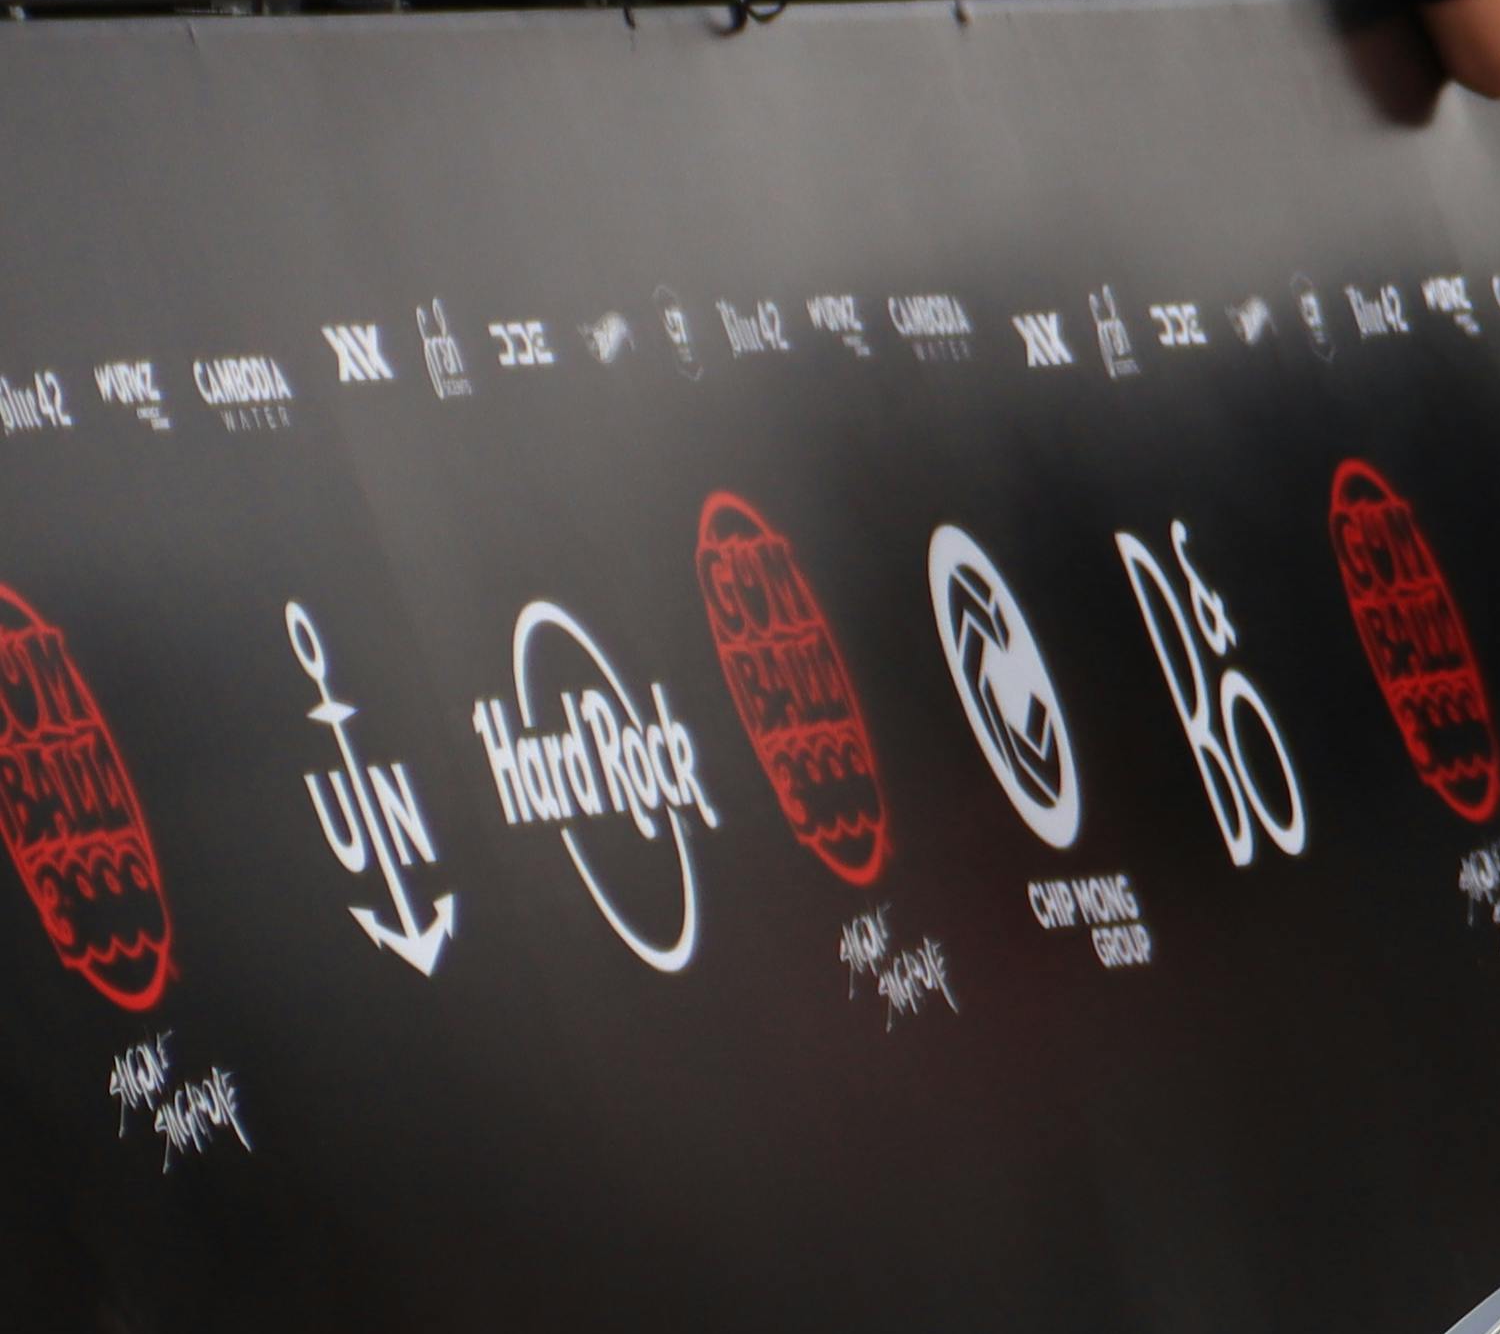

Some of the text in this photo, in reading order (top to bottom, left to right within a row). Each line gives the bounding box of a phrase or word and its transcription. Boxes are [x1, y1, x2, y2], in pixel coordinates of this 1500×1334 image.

[192, 357, 292, 405] CAMBODIA
[220, 407, 291, 433] WATER
[473, 681, 719, 839] Hard Rock
[1027, 873, 1140, 930] CHIP MONG
[1091, 924, 1152, 969] GROUP
